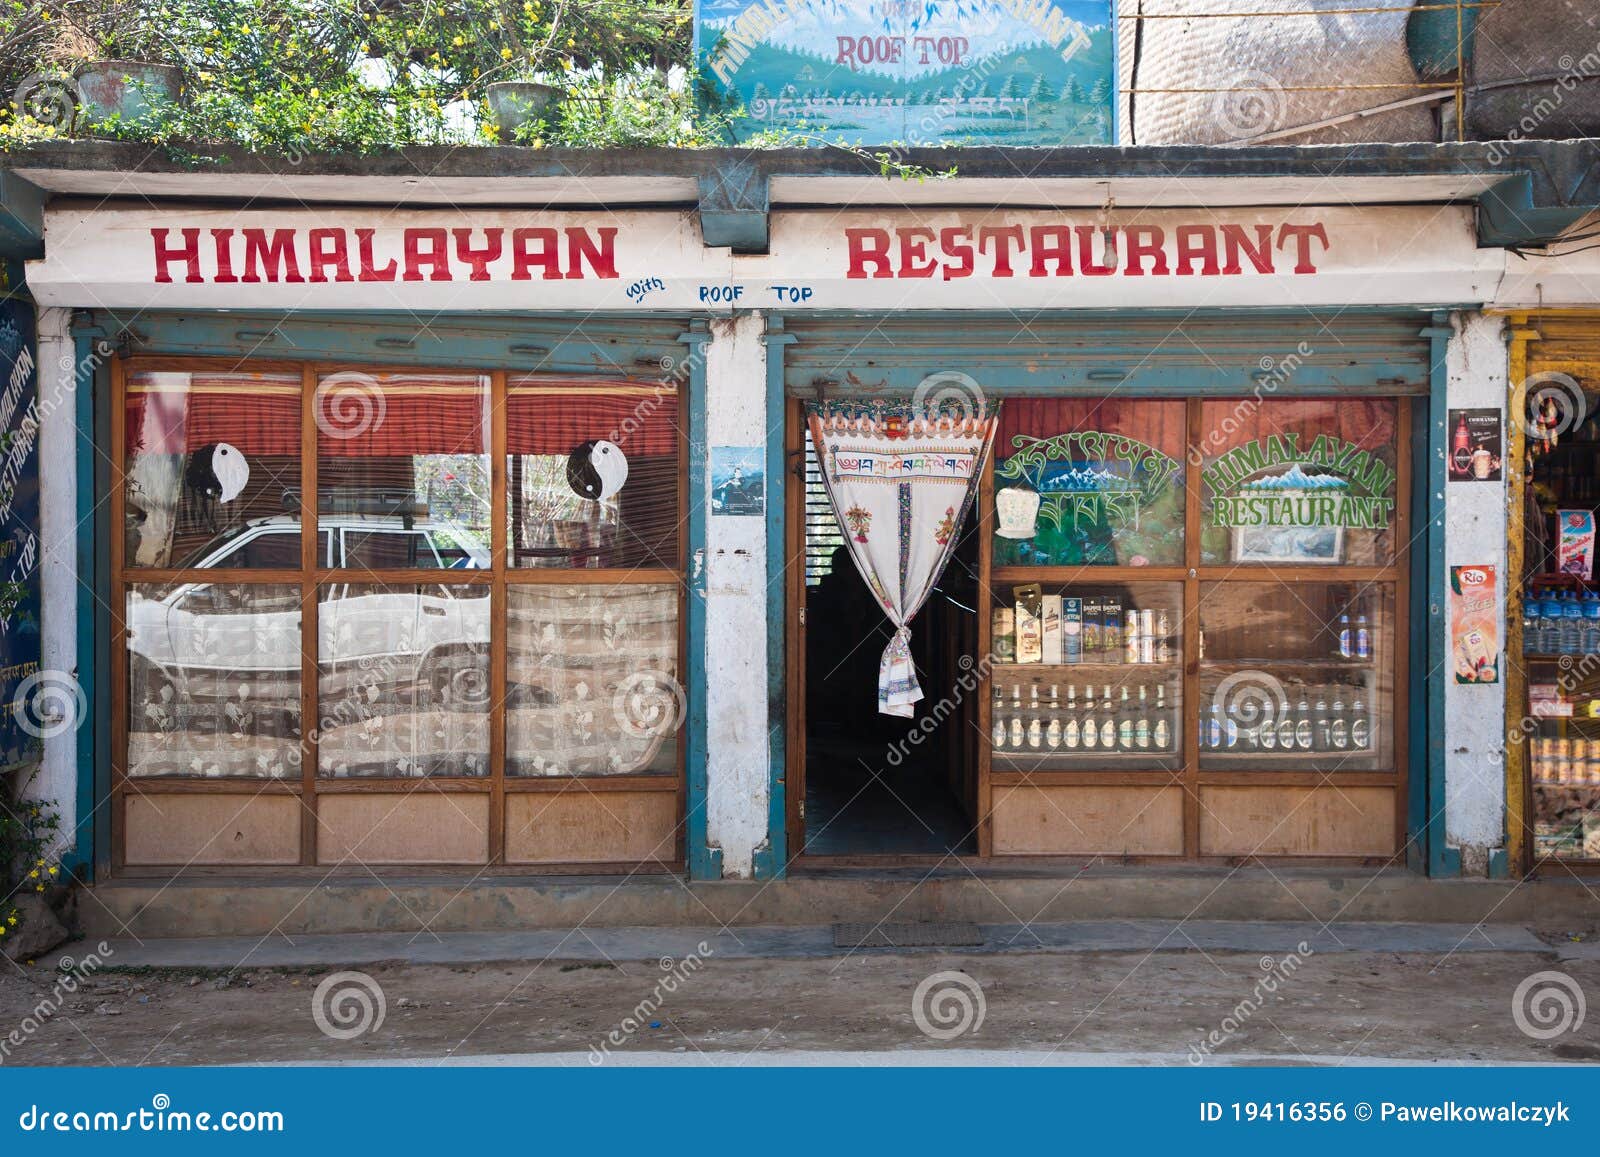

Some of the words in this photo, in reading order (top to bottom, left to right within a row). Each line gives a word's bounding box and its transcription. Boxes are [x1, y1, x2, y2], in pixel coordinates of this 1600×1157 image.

[836, 36, 905, 71] ROOF
[913, 36, 969, 65] TOP
[151, 227, 619, 283] HIMALAYAN
[845, 222, 1329, 281] RESTAURANT
[699, 285, 744, 303] ROOF
[772, 286, 813, 303] TOP
[0, 345, 35, 435] MALAYAN
[1202, 432, 1397, 498] HIMALAYAN
[1211, 495, 1394, 530] RESTAURANT
[17, 533, 36, 579] TOP
[1463, 571, 1484, 583] Rio
